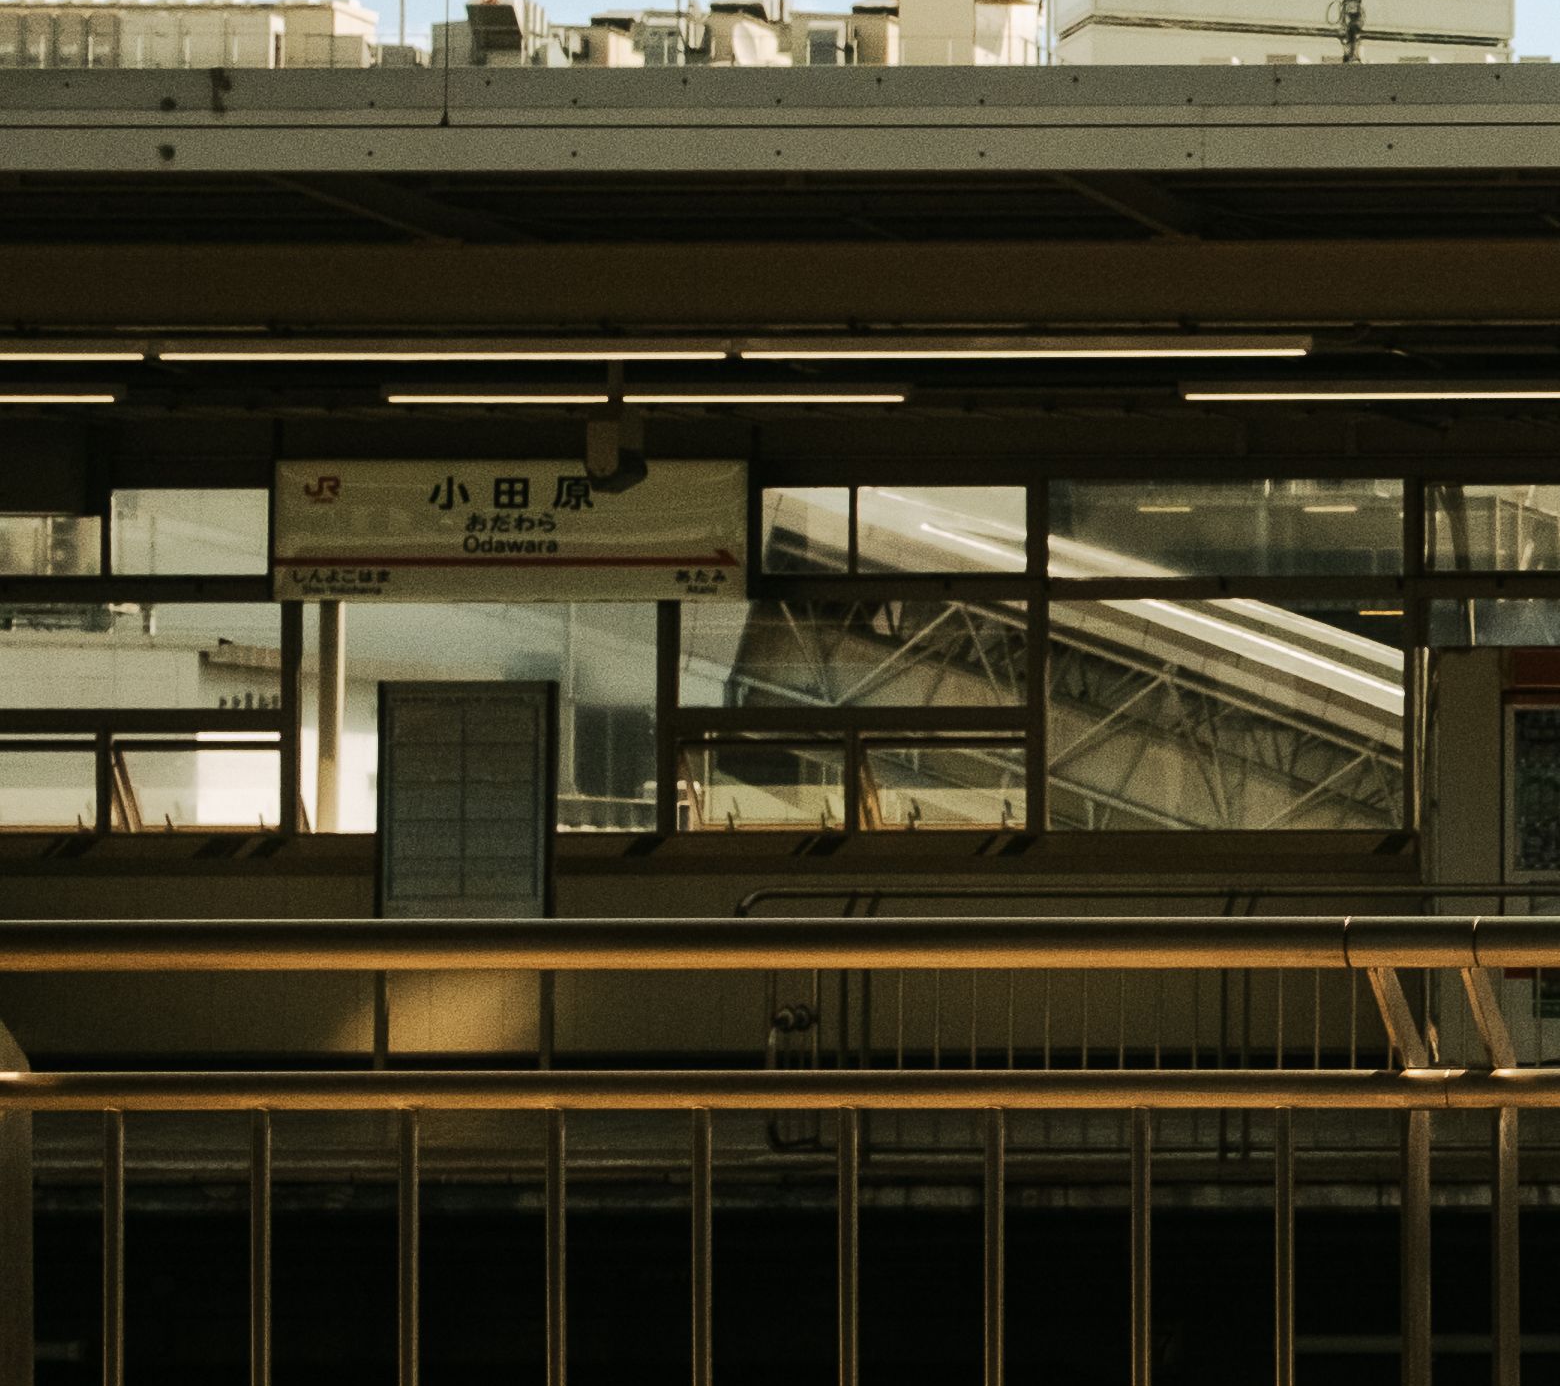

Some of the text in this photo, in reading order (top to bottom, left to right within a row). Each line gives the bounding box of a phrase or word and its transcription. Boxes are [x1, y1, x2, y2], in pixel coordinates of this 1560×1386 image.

[304, 476, 341, 498] JR
[428, 475, 595, 511] 小田原
[465, 512, 558, 533] おだわら
[463, 535, 559, 554] Odawara
